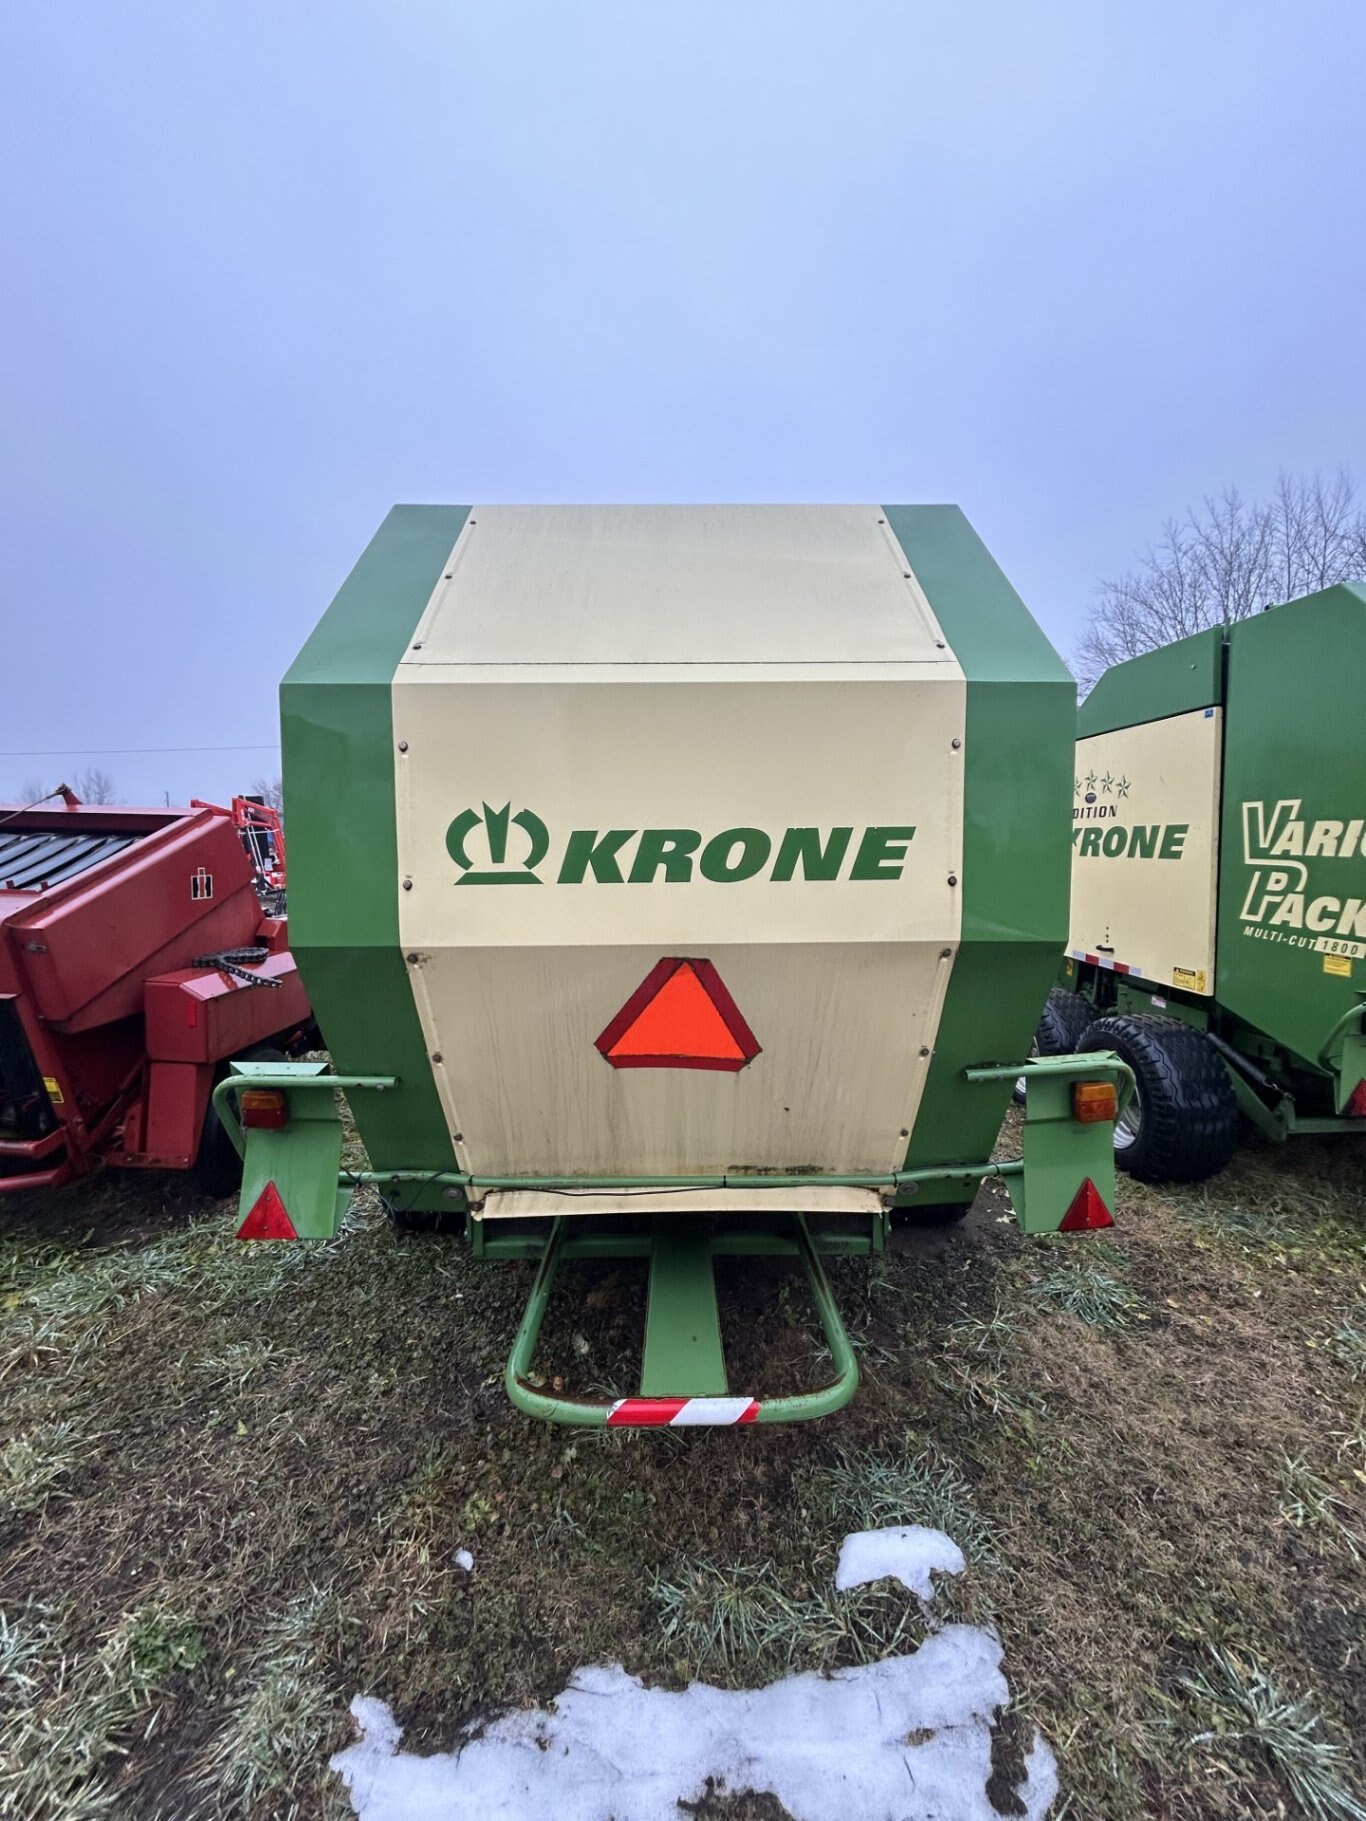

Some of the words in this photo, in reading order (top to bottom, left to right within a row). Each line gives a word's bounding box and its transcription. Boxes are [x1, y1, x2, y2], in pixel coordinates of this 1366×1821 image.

[1073, 805, 1118, 819] DITION
[1242, 799, 1366, 864] VARI
[556, 826, 917, 884] KRONE
[1243, 925, 1317, 950] MULTI-CUT
[1322, 940, 1359, 956] 1800
